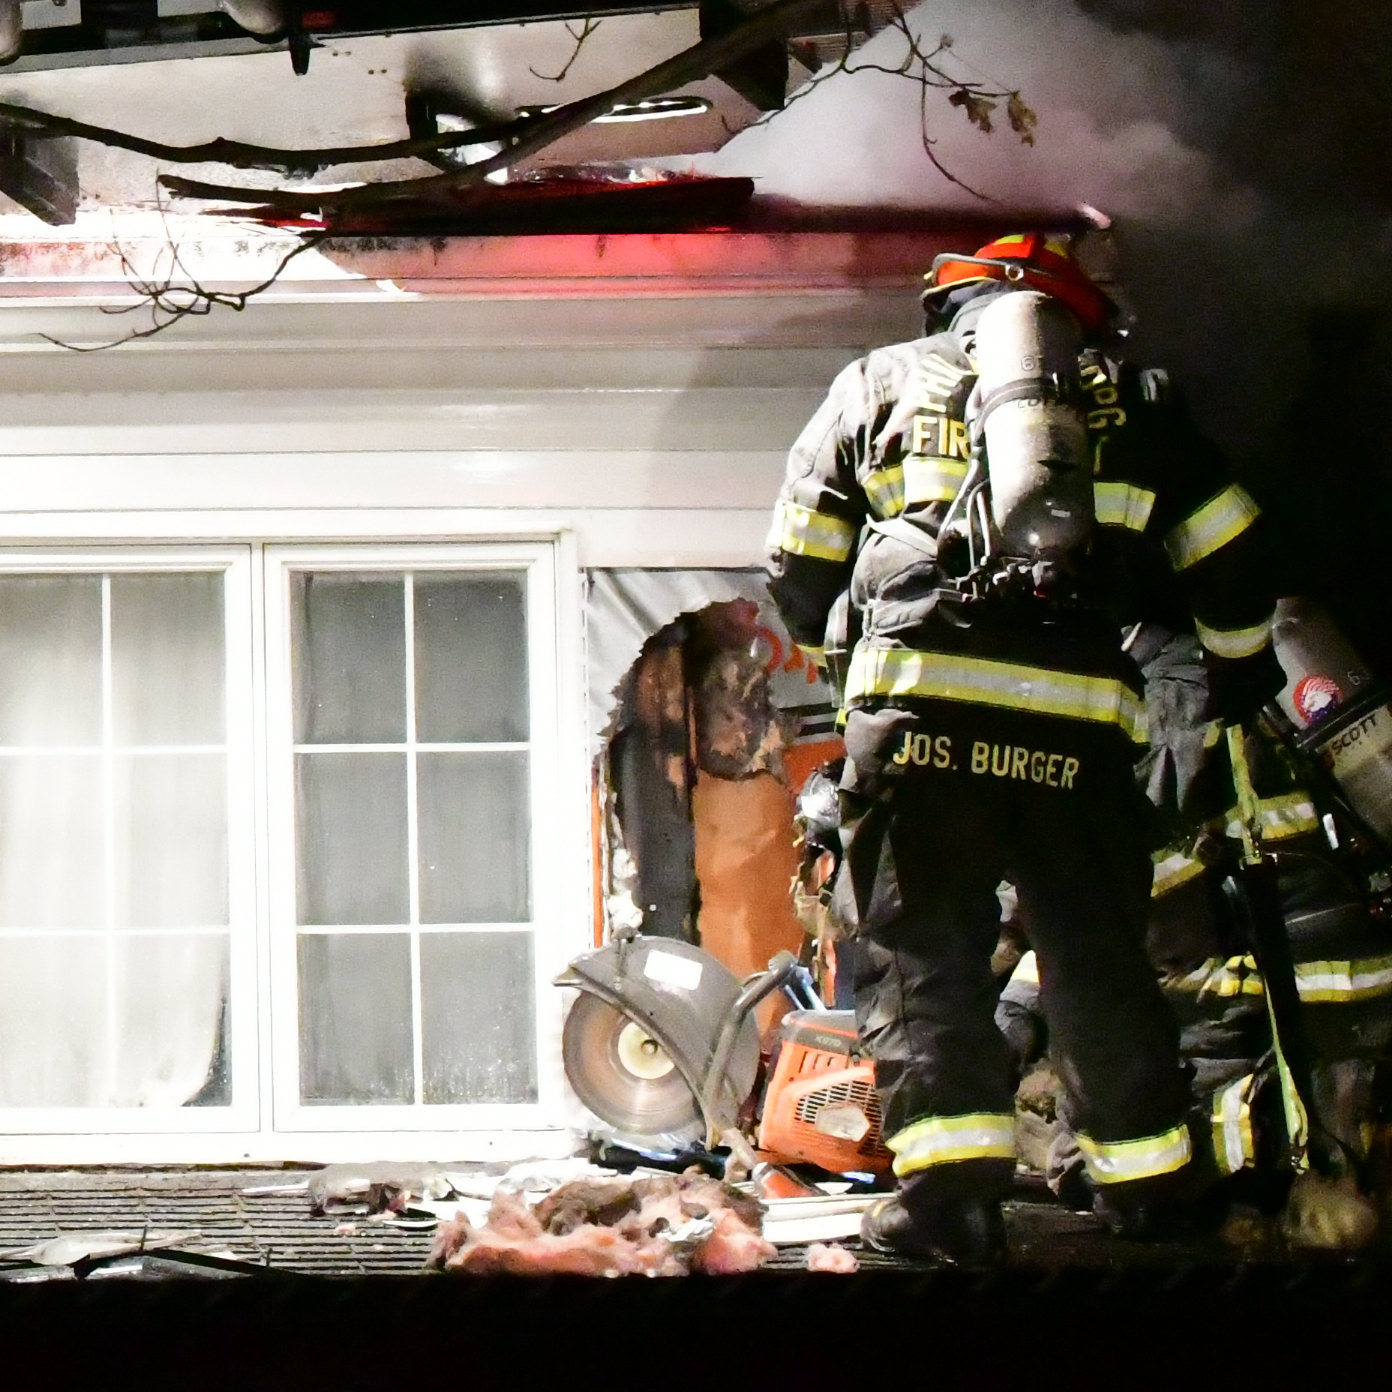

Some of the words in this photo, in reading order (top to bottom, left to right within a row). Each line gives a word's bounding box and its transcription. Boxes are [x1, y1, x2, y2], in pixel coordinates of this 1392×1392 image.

[1331, 712, 1378, 755] SCOTT
[892, 730, 958, 771] JOS.
[970, 740, 1080, 791] BURGER
